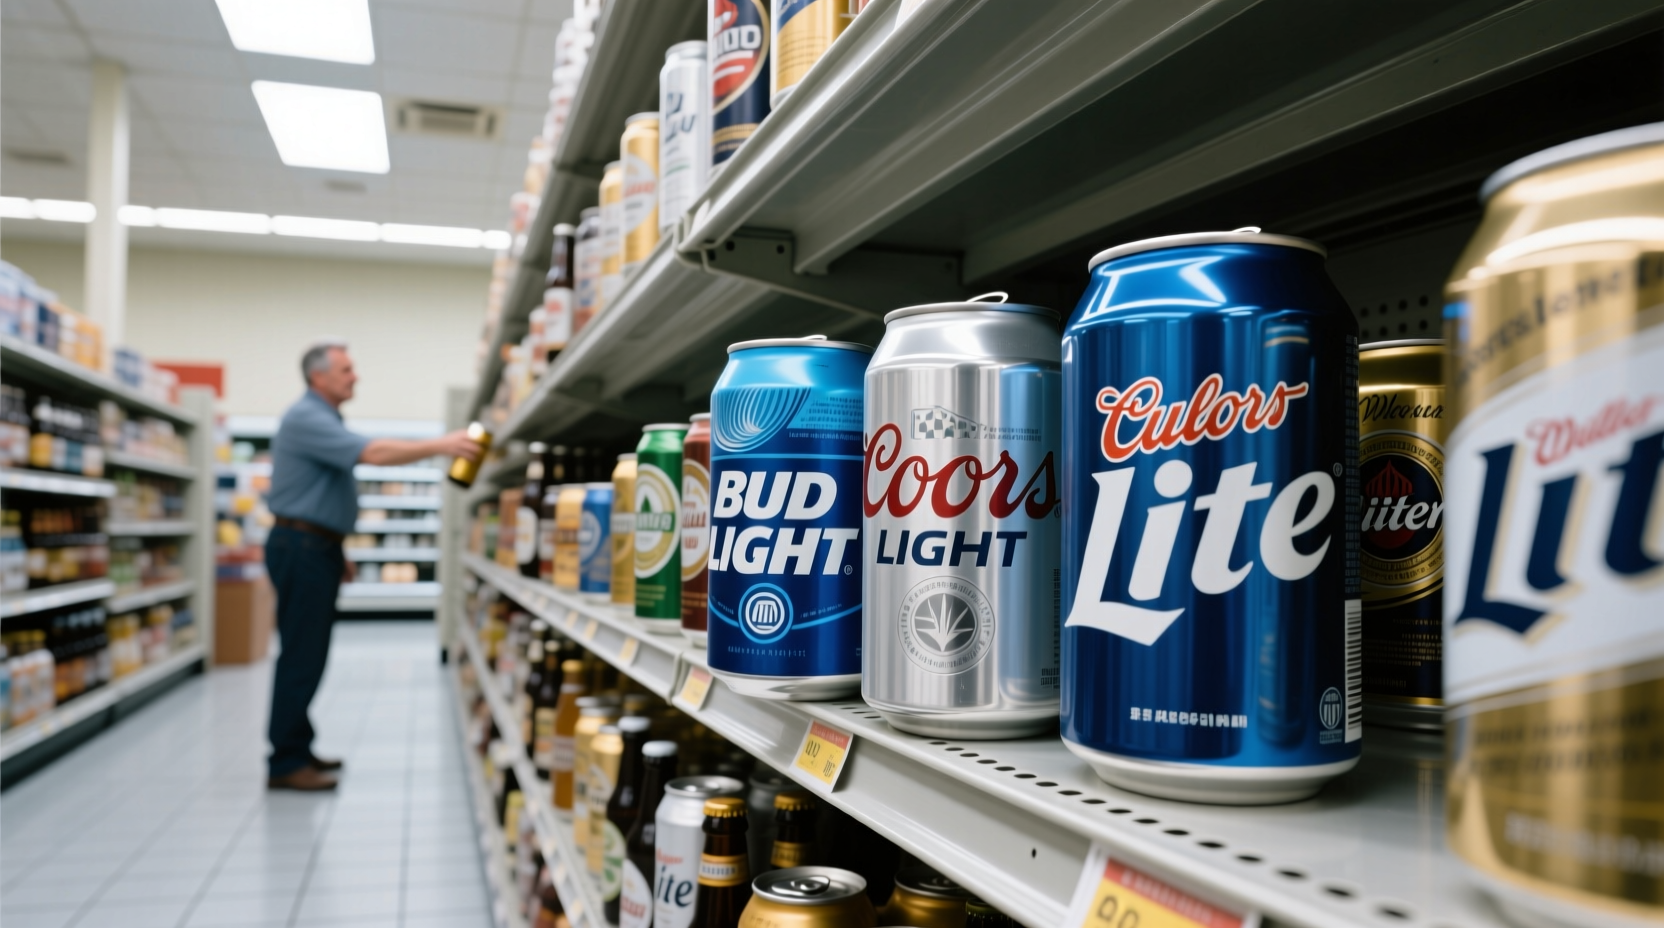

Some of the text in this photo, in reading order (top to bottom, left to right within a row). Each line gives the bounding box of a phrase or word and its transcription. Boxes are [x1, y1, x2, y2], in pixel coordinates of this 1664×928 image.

[713, 470, 837, 520] BUD
[863, 423, 1061, 519] Coors
[708, 526, 860, 576] LIGHT
[876, 529, 1028, 568] LIGHT
[1064, 459, 1335, 646] Lite
